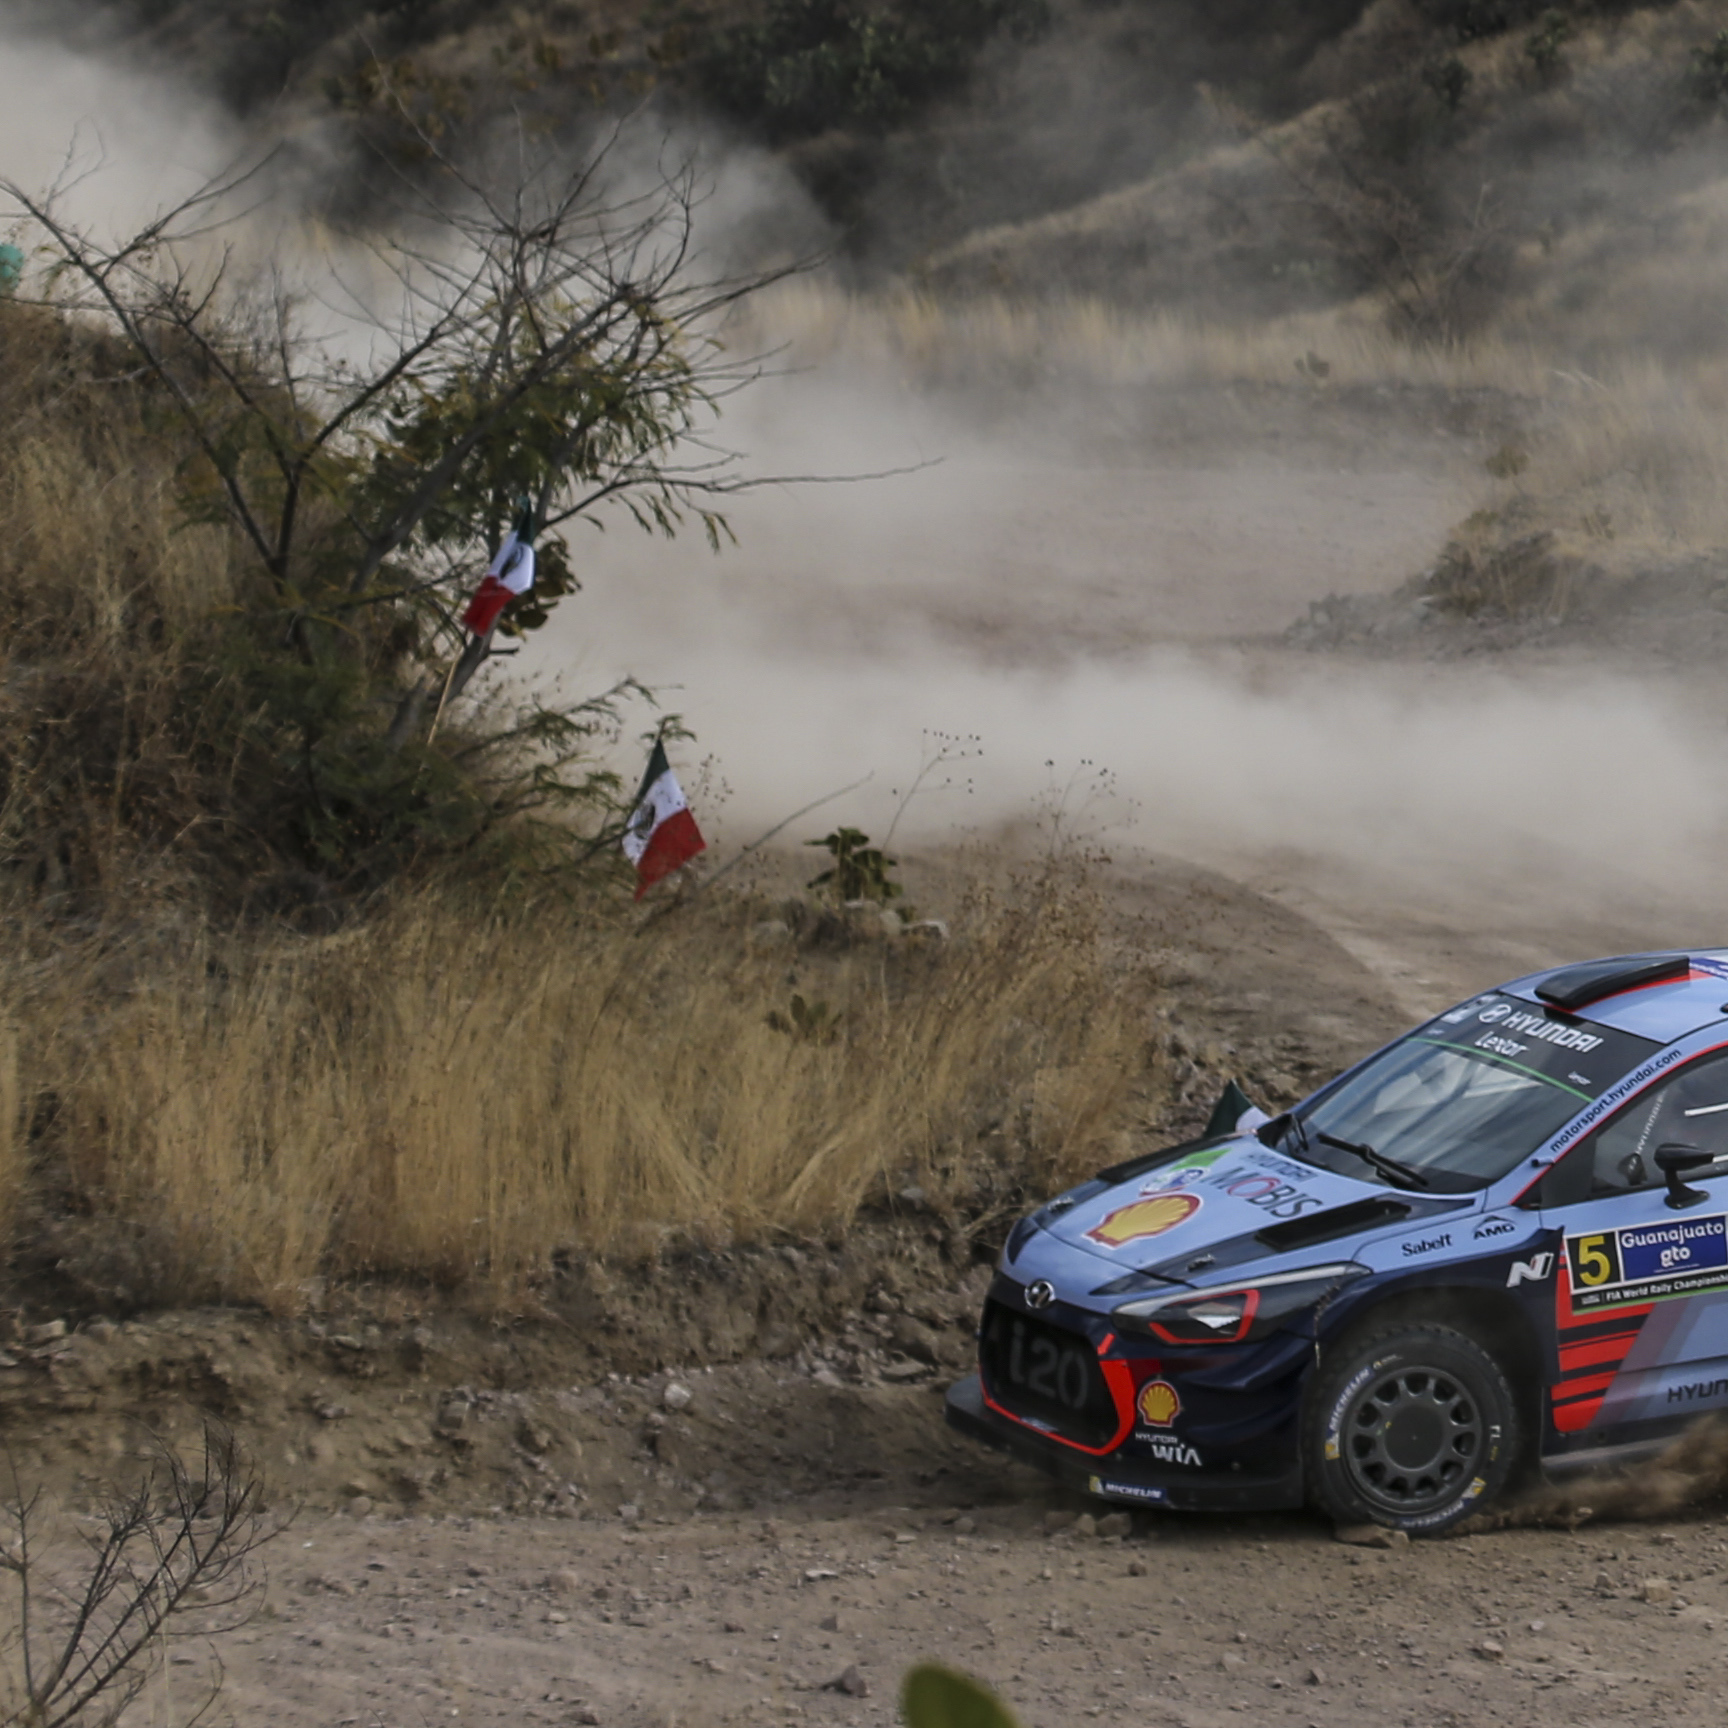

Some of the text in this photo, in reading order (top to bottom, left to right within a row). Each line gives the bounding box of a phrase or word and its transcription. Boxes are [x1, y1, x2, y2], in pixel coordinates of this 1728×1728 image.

[1474, 1030, 1528, 1058] Lexar
[1502, 1011, 1604, 1053] HYUNDAI
[1550, 1049, 1682, 1152] motorsport.hyundai.com
[1202, 1166, 1322, 1218] MOBIS
[1402, 1233, 1452, 1257] Sabelt
[1621, 1222, 1725, 1248] Guanajuato
[1579, 1235, 1611, 1286] 5
[1660, 1245, 1692, 1268] gto
[1622, 1286, 1648, 1299] World
[1650, 1282, 1672, 1297] Rally
[1105, 1482, 1162, 1499] MICHELIN
